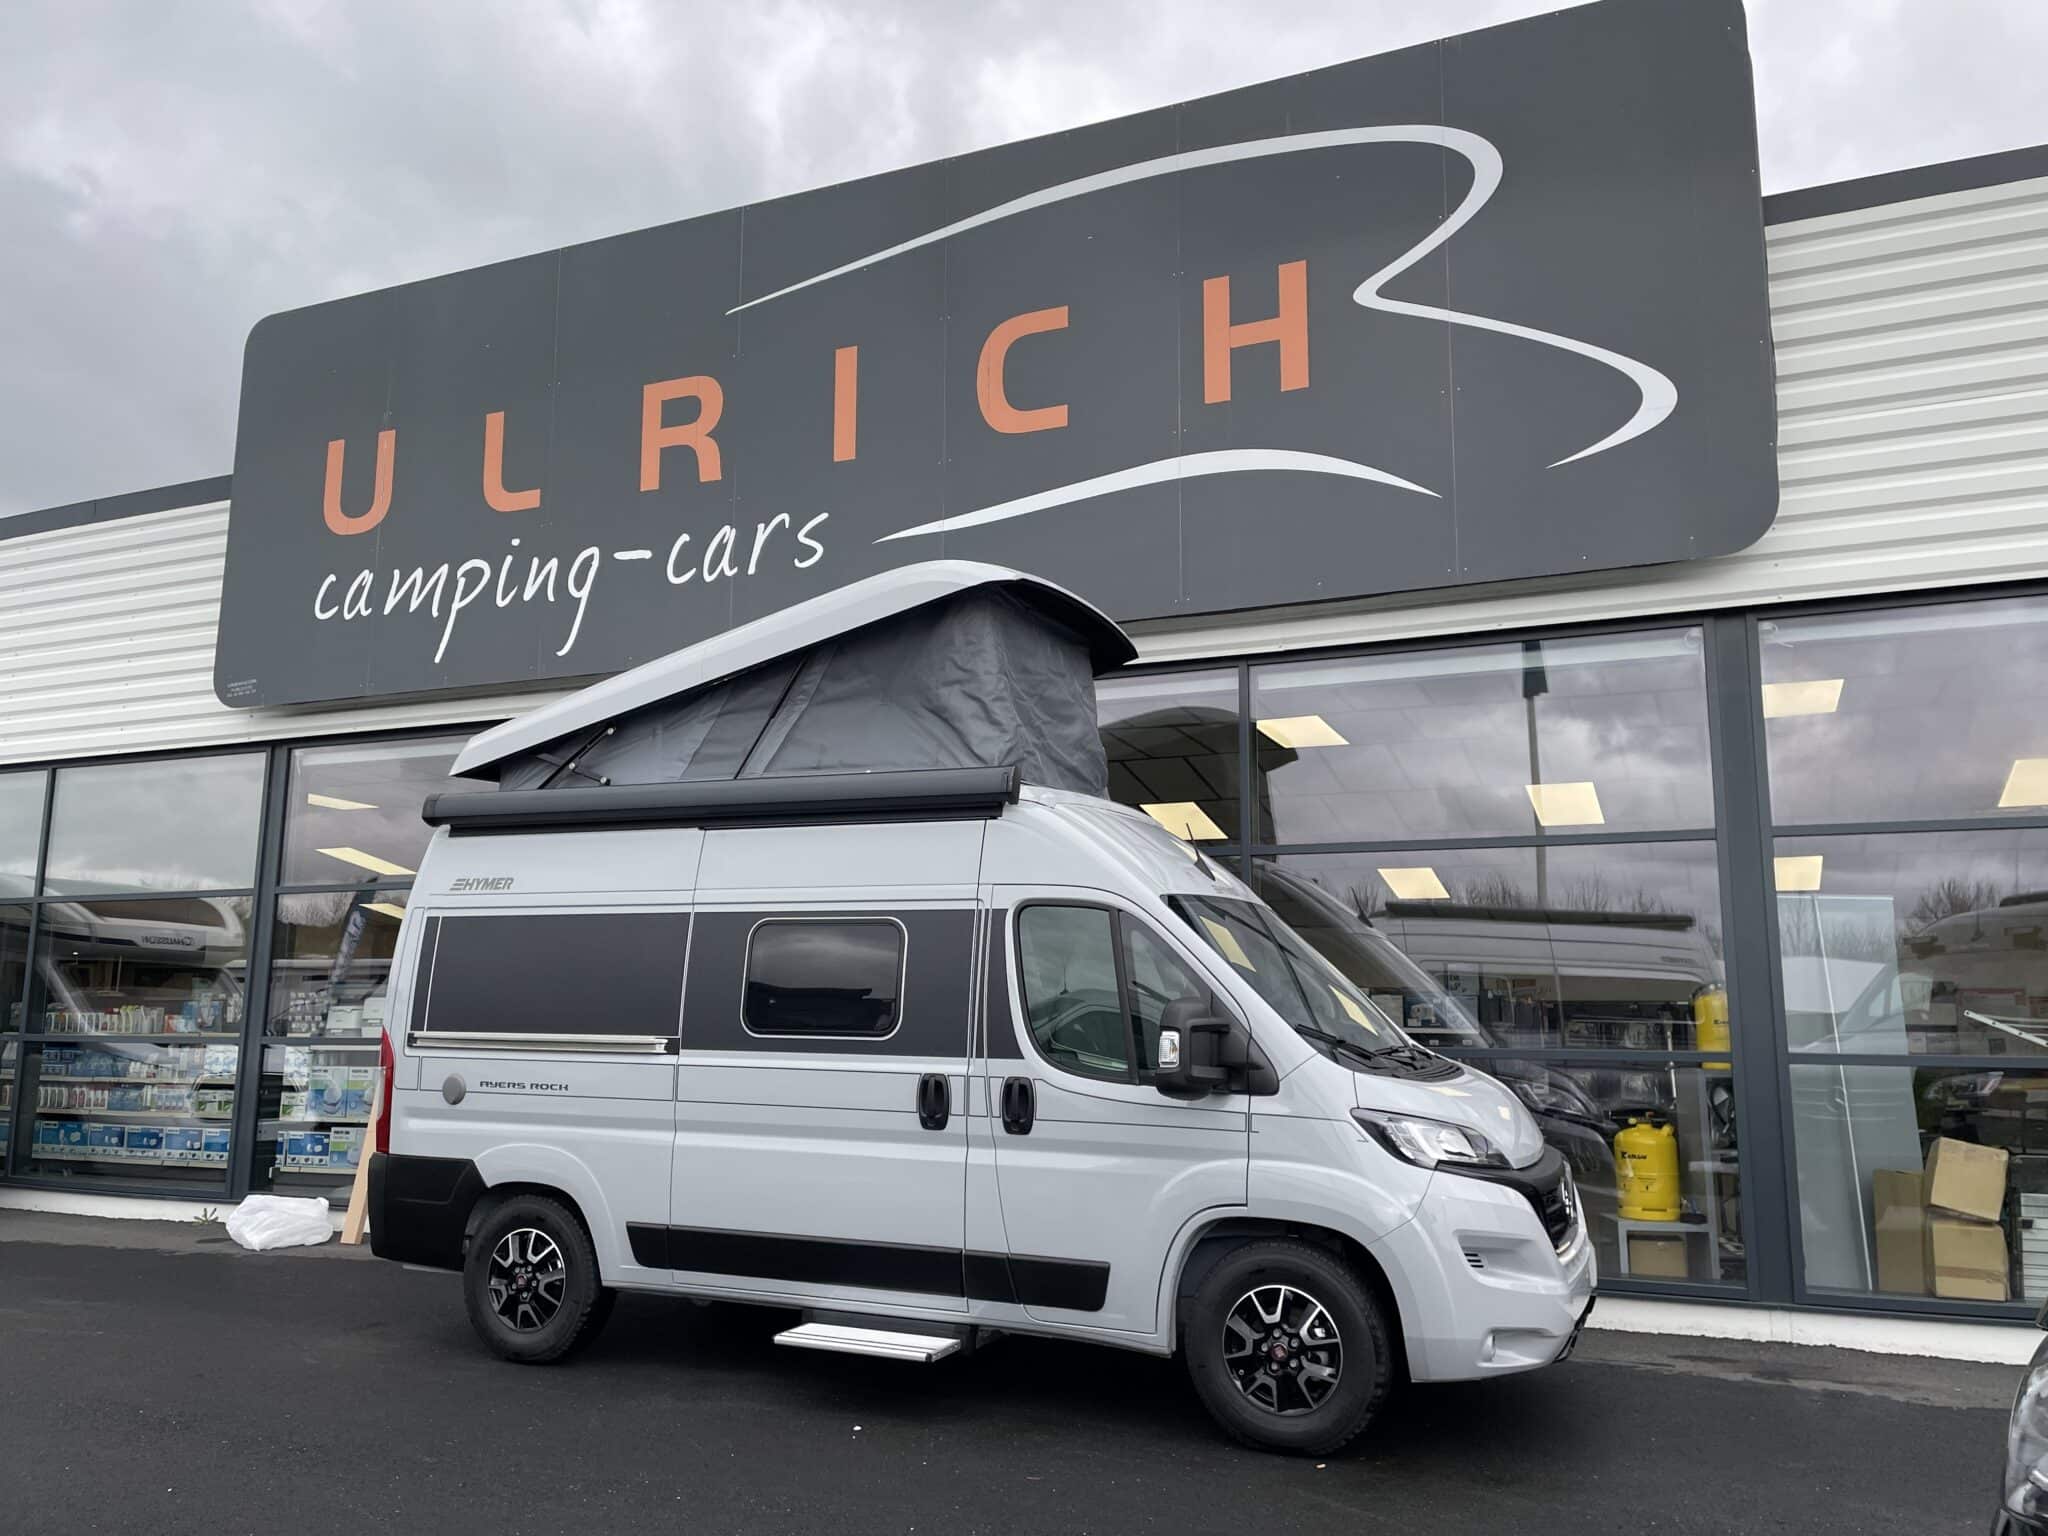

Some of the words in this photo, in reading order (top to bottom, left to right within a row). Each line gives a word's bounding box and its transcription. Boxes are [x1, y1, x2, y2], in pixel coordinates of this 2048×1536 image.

[323, 260, 1310, 535] ULRICH
[313, 511, 830, 665] camping-cars
[460, 877, 515, 891] HYMER
[479, 1080, 526, 1091] AYERS
[530, 1082, 569, 1092] ROCK
